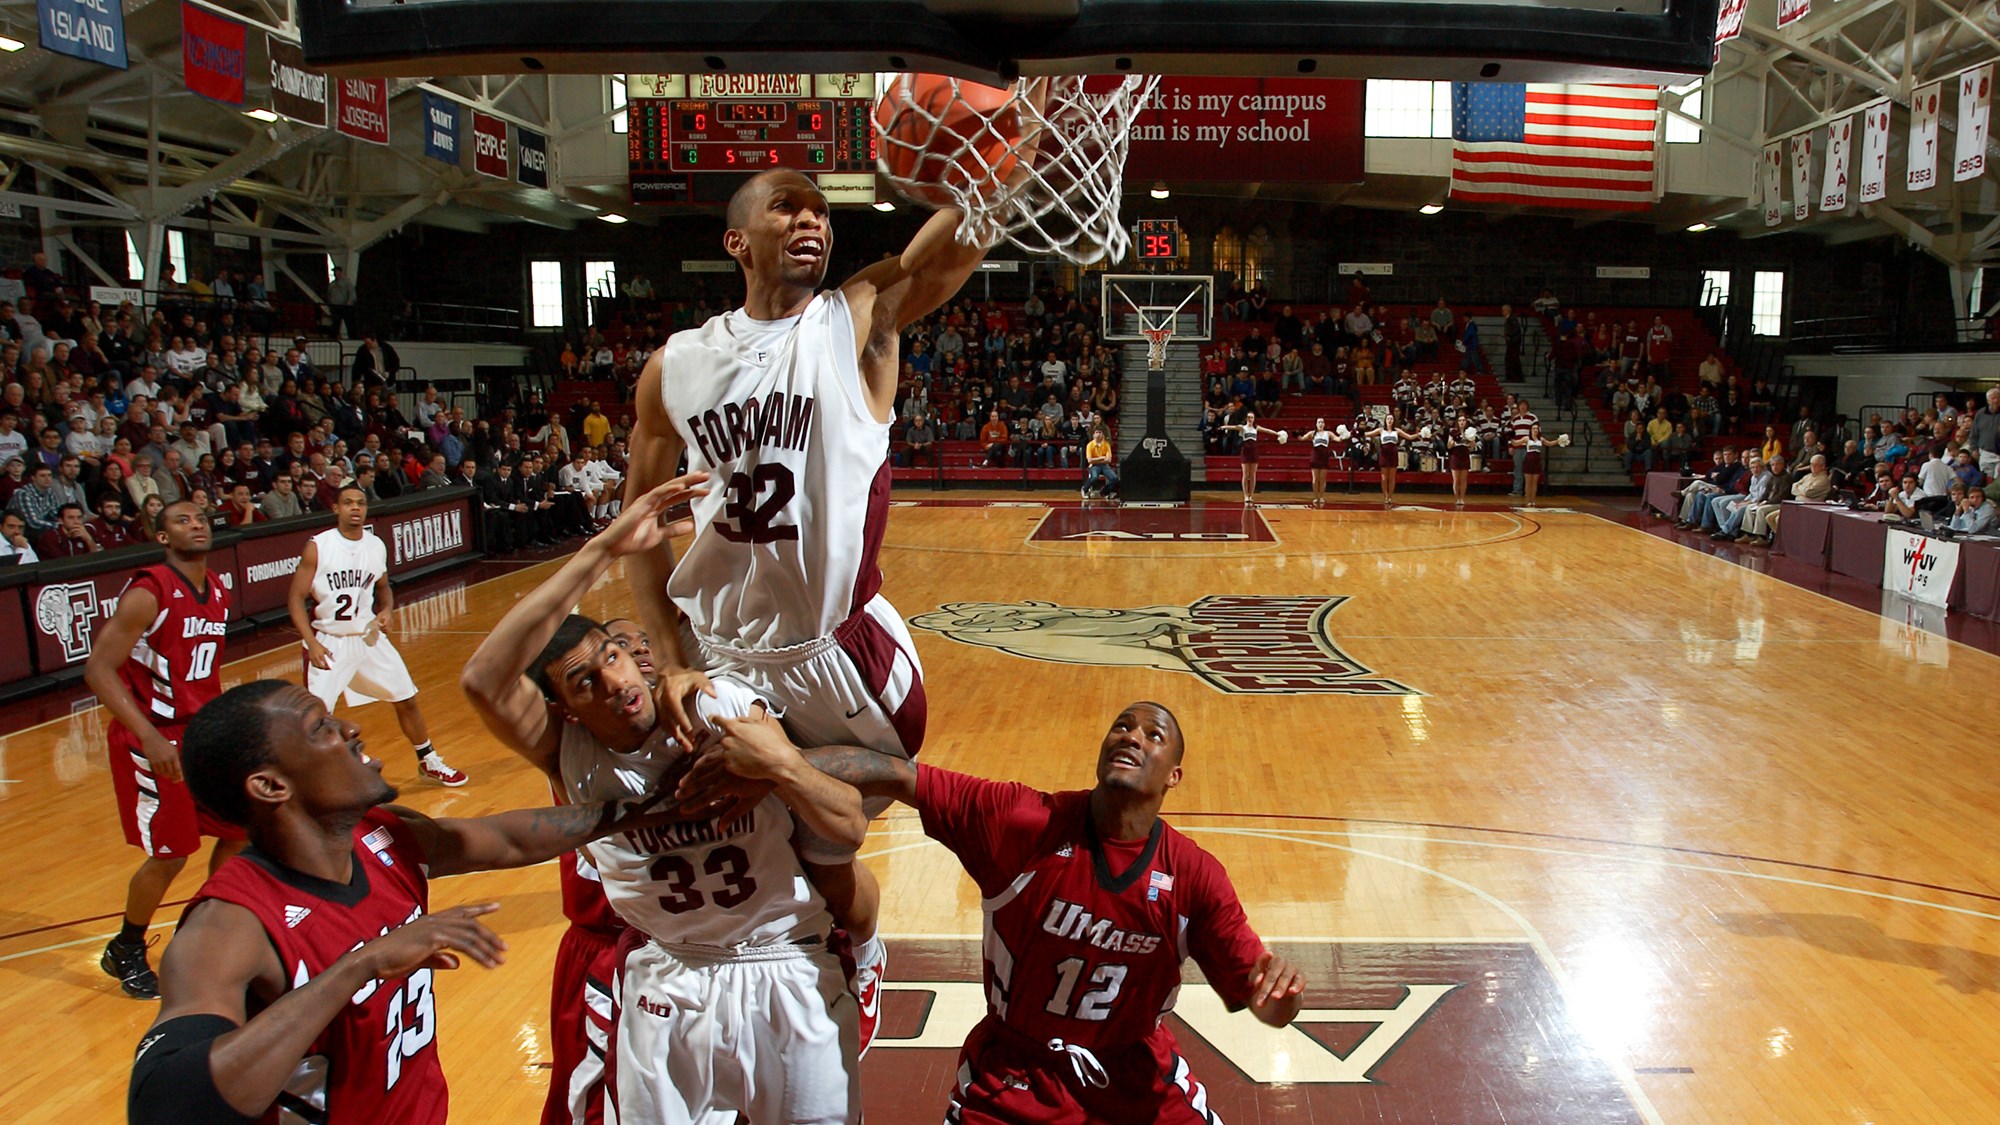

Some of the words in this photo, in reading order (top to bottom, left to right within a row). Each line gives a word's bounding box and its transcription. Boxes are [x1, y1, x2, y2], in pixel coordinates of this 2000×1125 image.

[50, 8, 115, 52] ISLAND
[345, 79, 377, 104] SAINT
[702, 74, 799, 95] FORDHAM
[1109, 86, 1168, 110] ork
[1173, 87, 1191, 110] is
[1198, 94, 1233, 117] my
[1238, 94, 1326, 117] campus
[342, 105, 385, 133] JOSEPH
[430, 107, 453, 130] SAINT
[695, 114, 705, 130] 0
[811, 114, 821, 130] 0
[432, 129, 453, 152] LOUIS
[473, 129, 507, 160] TEMPLE
[1172, 119, 1190, 141] is
[1196, 125, 1232, 148] my
[1237, 119, 1310, 142] school
[520, 145, 546, 172] XAVIER
[689, 150, 697, 163] 0
[726, 149, 735, 163] 5
[769, 149, 779, 163] 5
[816, 150, 824, 163] 0
[1145, 235, 1171, 256] 35
[758, 352, 767, 362] F
[713, 462, 799, 544] 32
[392, 509, 464, 566] FORDHAM
[186, 641, 217, 681] 10
[651, 845, 758, 914] 33
[1046, 956, 1128, 1022] 12
[636, 995, 671, 1019] A10
[386, 968, 434, 1092] 23
